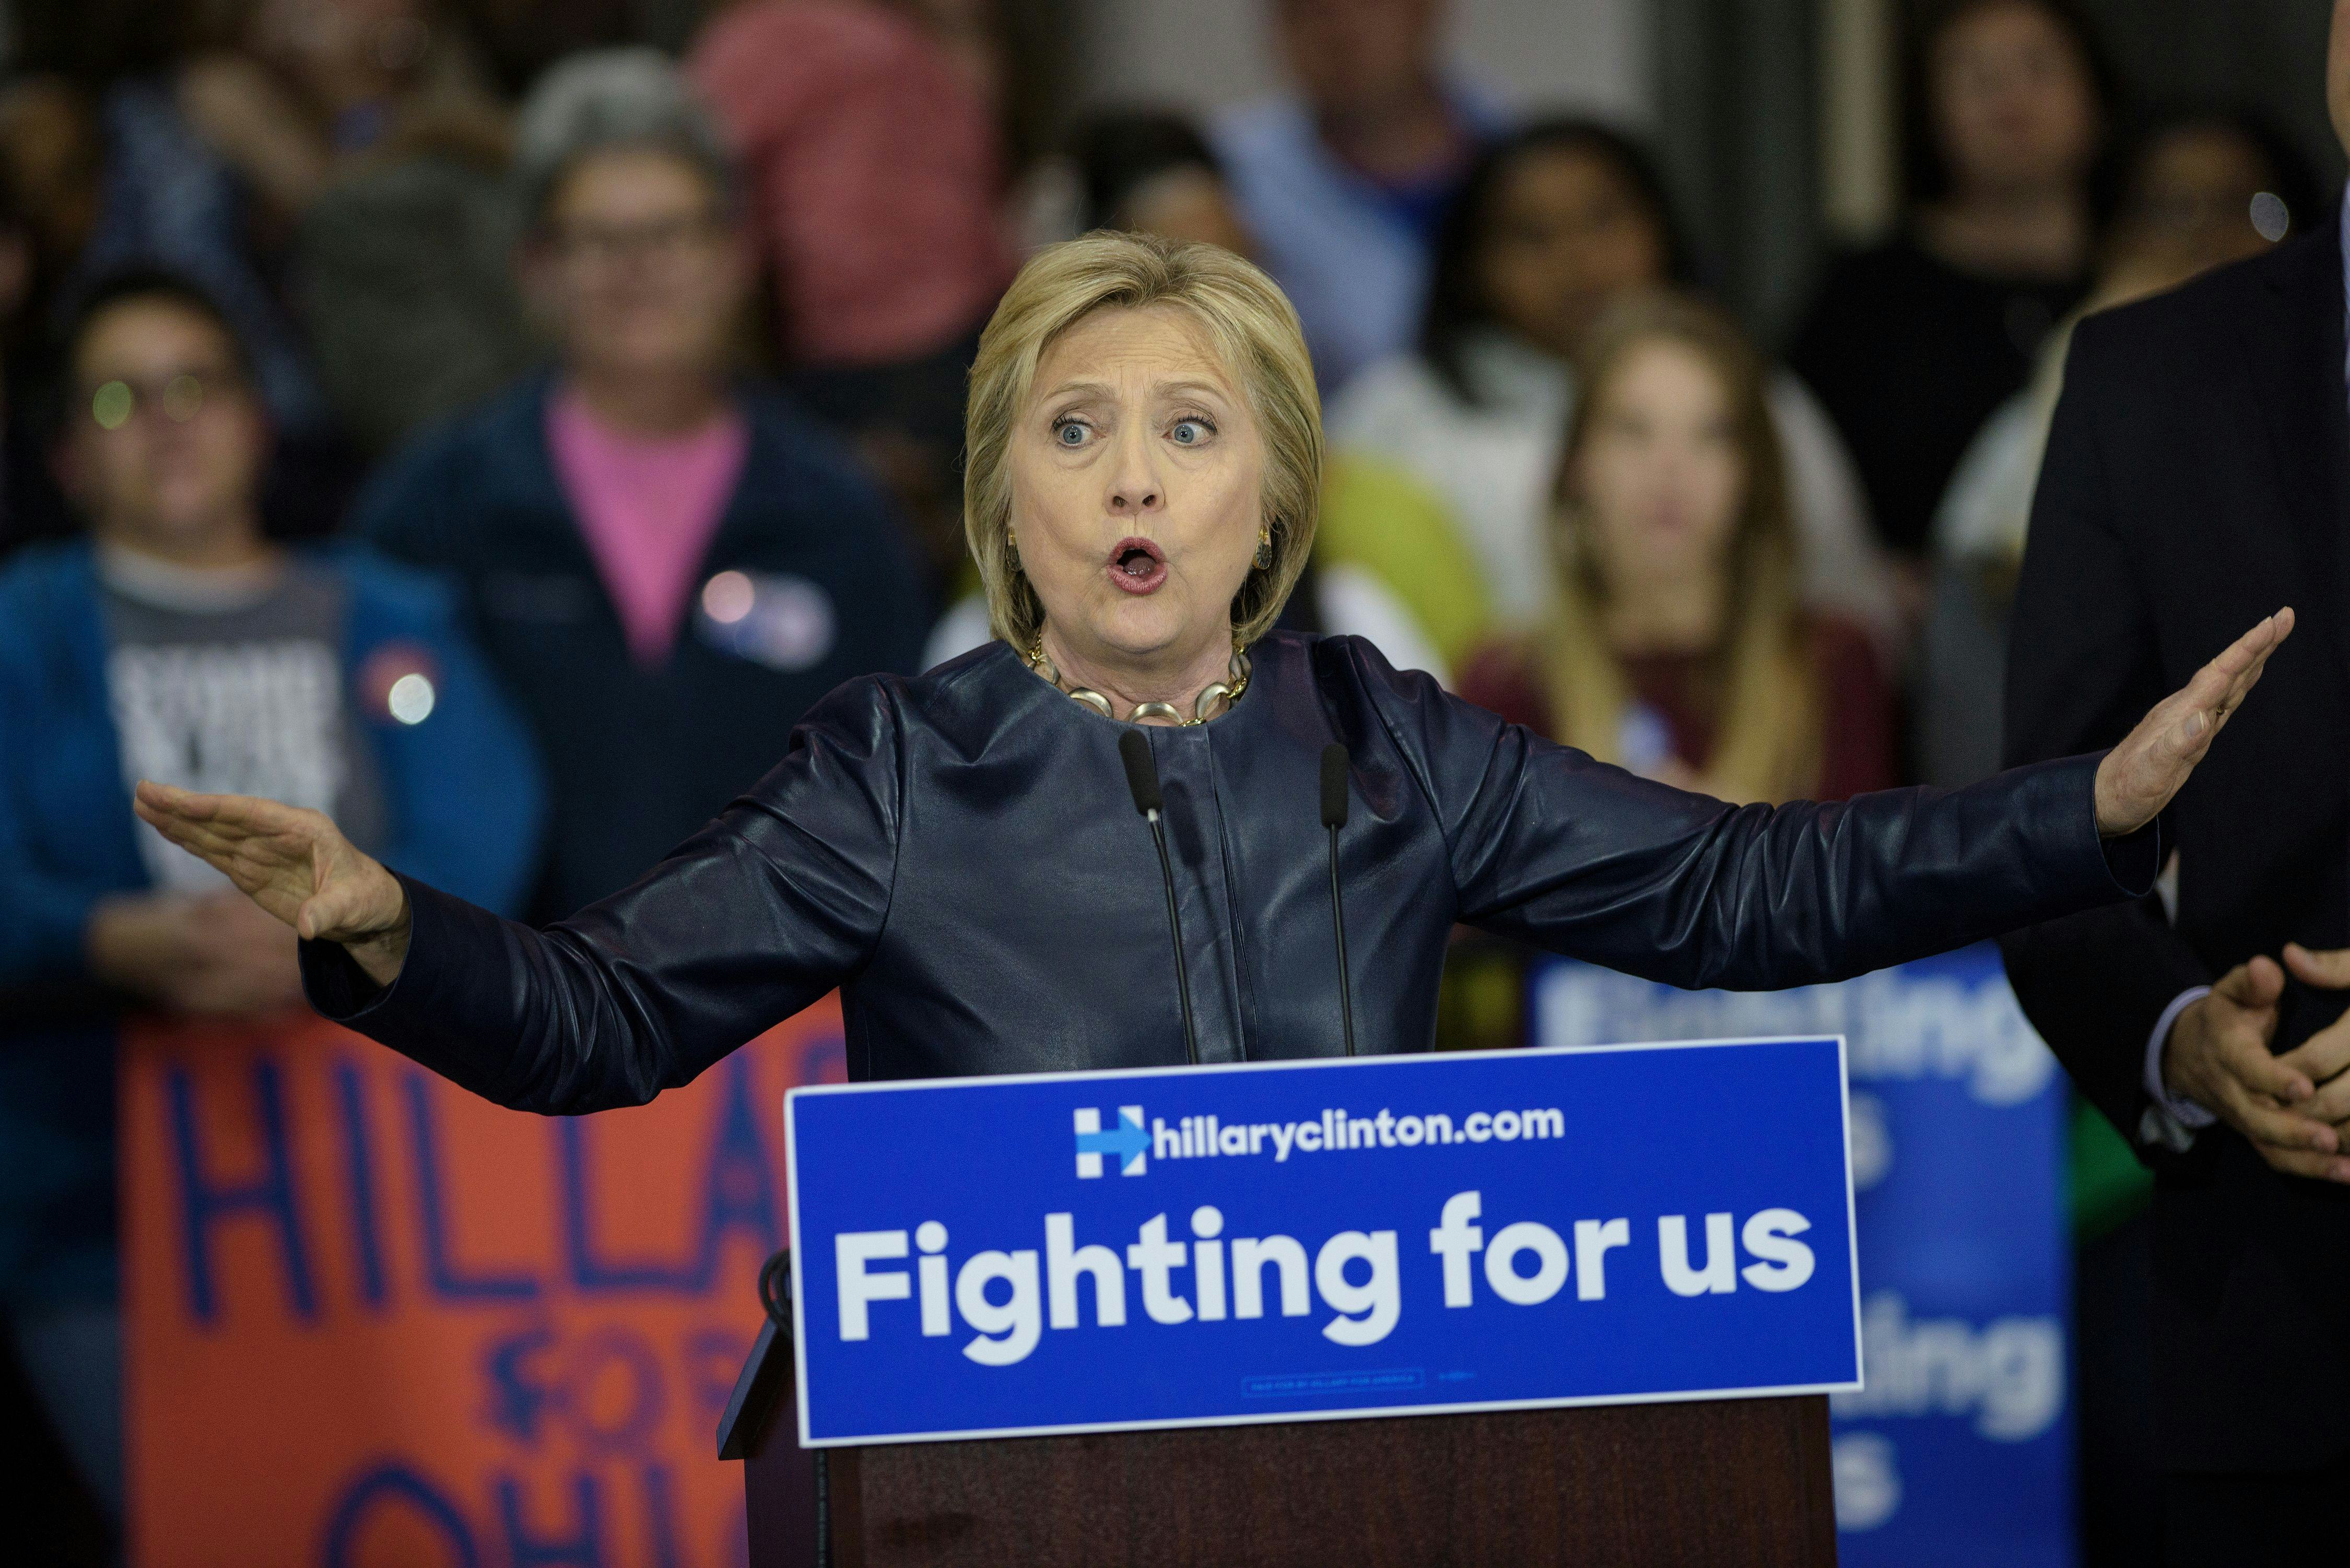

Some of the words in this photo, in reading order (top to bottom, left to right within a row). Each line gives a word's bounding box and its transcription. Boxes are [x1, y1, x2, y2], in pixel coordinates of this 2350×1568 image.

[163, 1038, 847, 1331] HILLA
[1152, 1108, 1565, 1162] hillaryclinton.com
[835, 1205, 1401, 1366] Fighting
[1430, 1190, 1630, 1308] for
[1658, 1208, 1815, 1296] us
